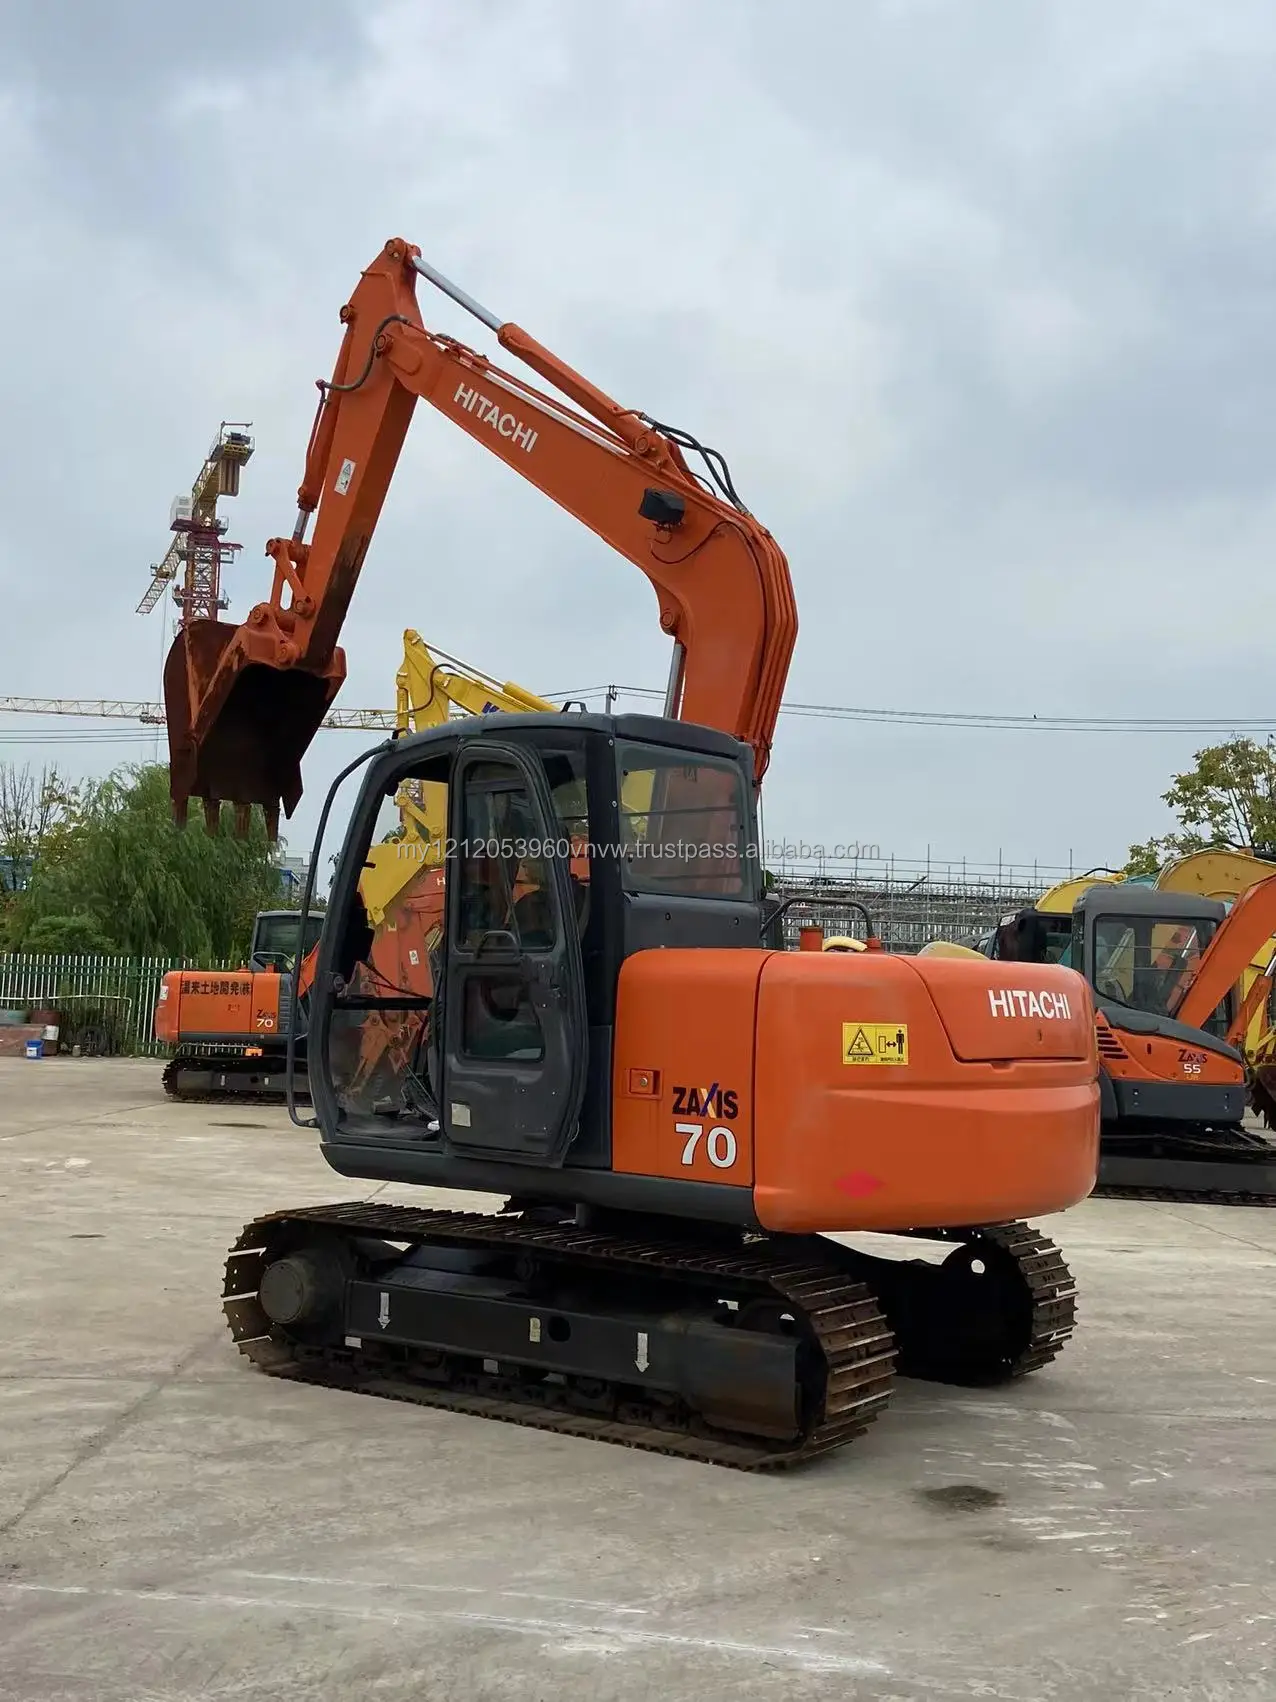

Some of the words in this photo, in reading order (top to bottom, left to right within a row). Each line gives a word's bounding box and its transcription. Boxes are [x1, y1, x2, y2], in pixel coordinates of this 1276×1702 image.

[453, 381, 539, 453] HITACHI
[987, 989, 1072, 1020] HITACHI
[256, 1018, 274, 1028] 70
[1183, 1063, 1201, 1074] 55
[672, 1082, 739, 1120] ZAXIS
[675, 1122, 737, 1169] 70
